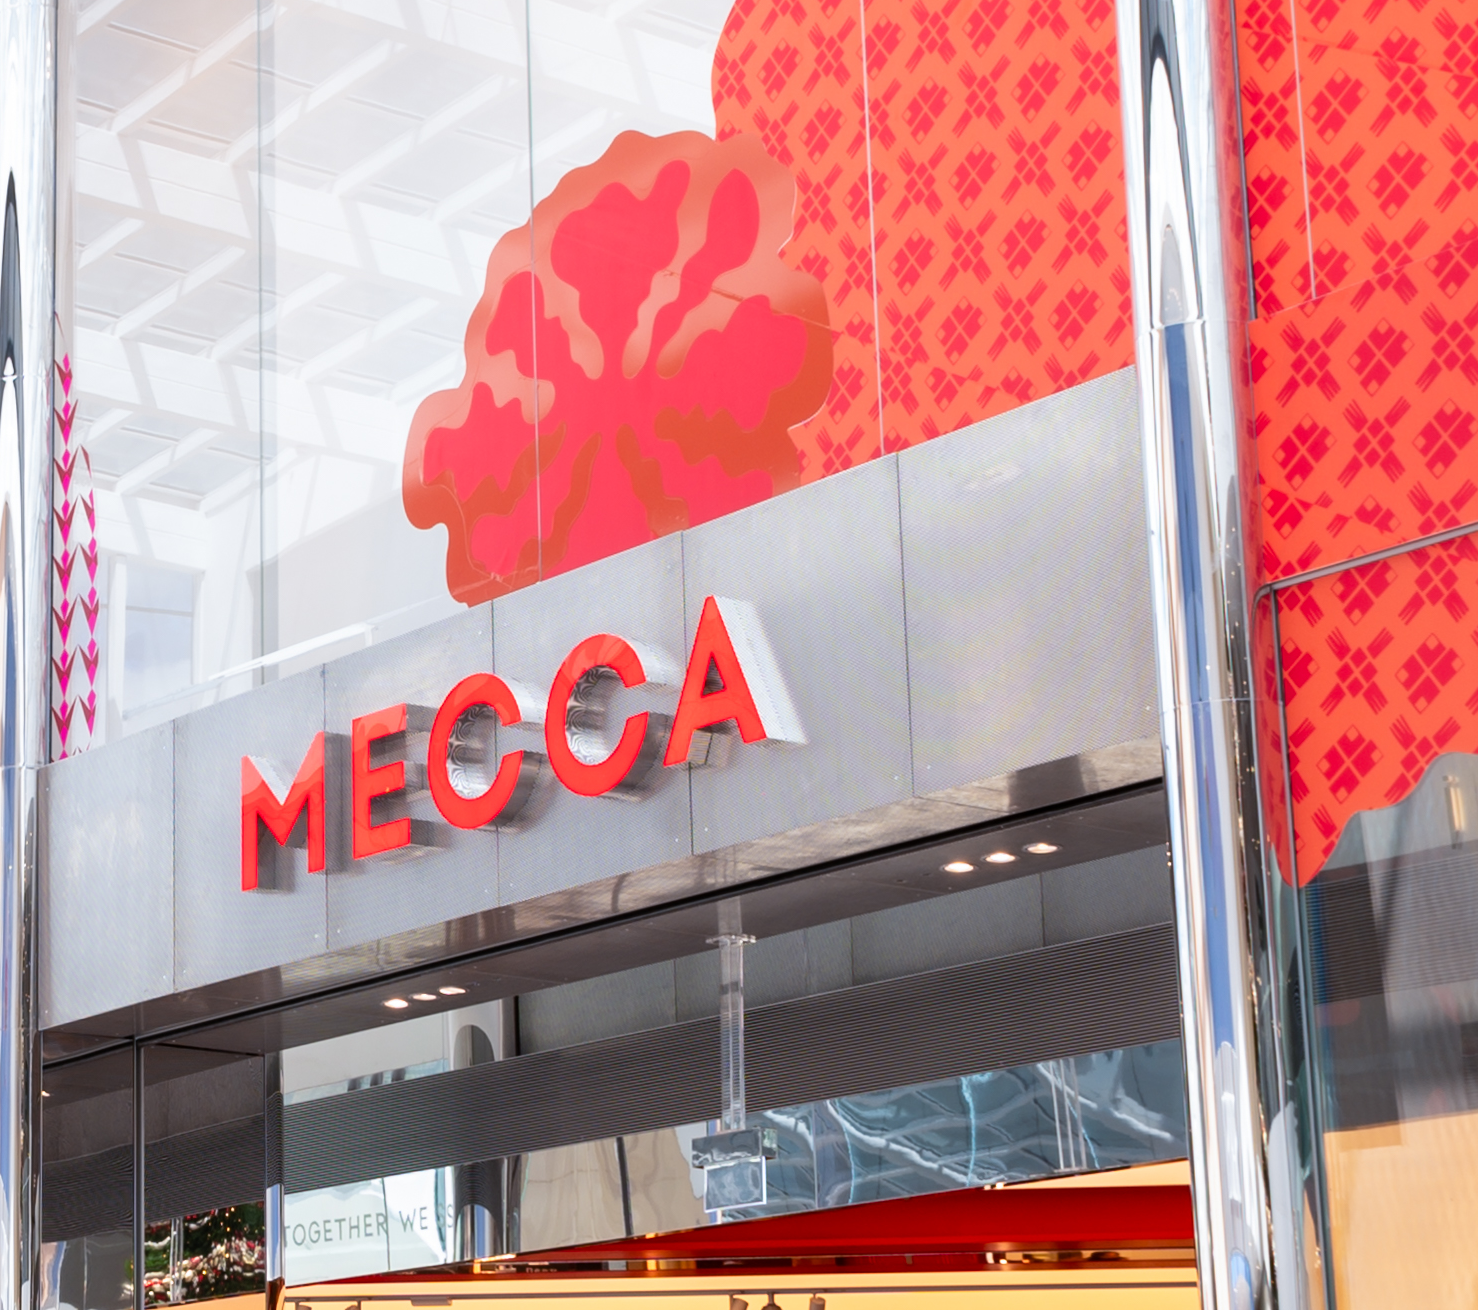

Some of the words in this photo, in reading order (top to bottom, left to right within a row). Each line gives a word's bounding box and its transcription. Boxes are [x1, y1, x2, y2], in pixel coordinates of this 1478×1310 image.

[241, 595, 768, 891] MECCA
[285, 1212, 388, 1247] TOGETHER
[399, 1206, 428, 1233] WE
